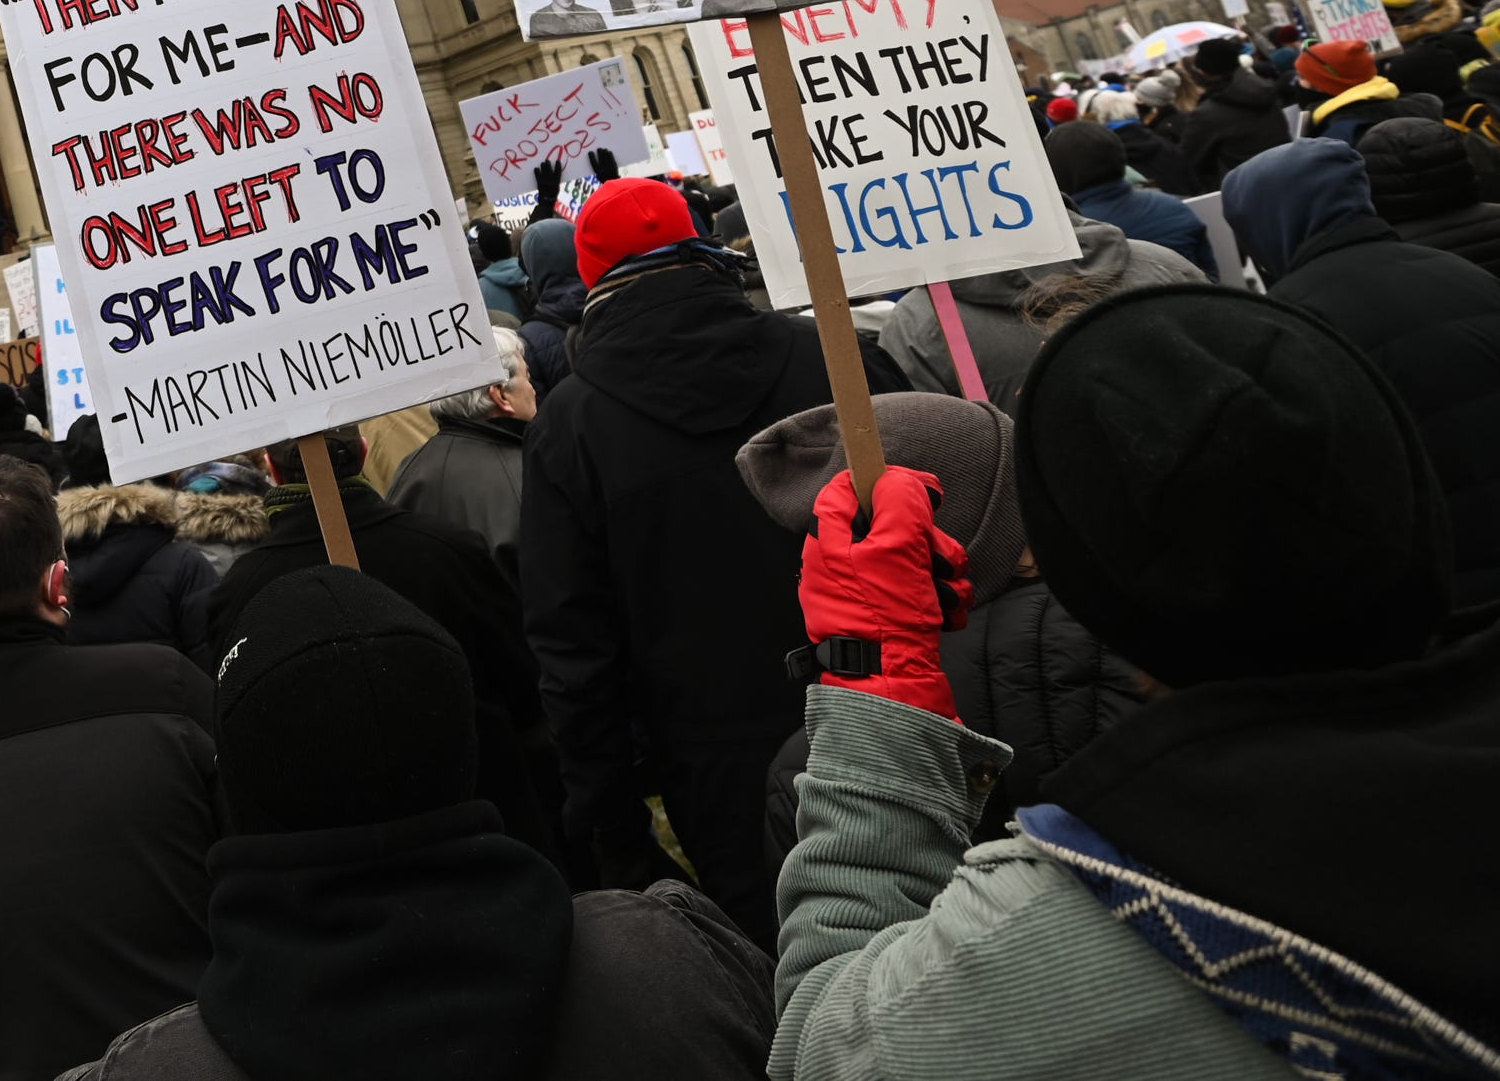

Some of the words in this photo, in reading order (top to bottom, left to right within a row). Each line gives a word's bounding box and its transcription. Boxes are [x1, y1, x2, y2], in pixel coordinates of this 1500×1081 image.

[43, 42, 155, 112] FOR
[471, 93, 541, 146] FUCK
[727, 50, 880, 112] TEN
[878, 33, 989, 94] THEY
[51, 109, 195, 193] THERE
[191, 87, 301, 158] WAS
[307, 70, 384, 135] NO
[489, 82, 585, 182] PROJECT
[882, 100, 1007, 158] YOUR
[80, 197, 189, 270] ONE
[185, 163, 301, 249] LEFT
[313, 147, 386, 213] TO
[100, 260, 257, 354] SPEAK
[253, 234, 355, 316] FOR
[281, 301, 483, 398] NIEMÖLLER
